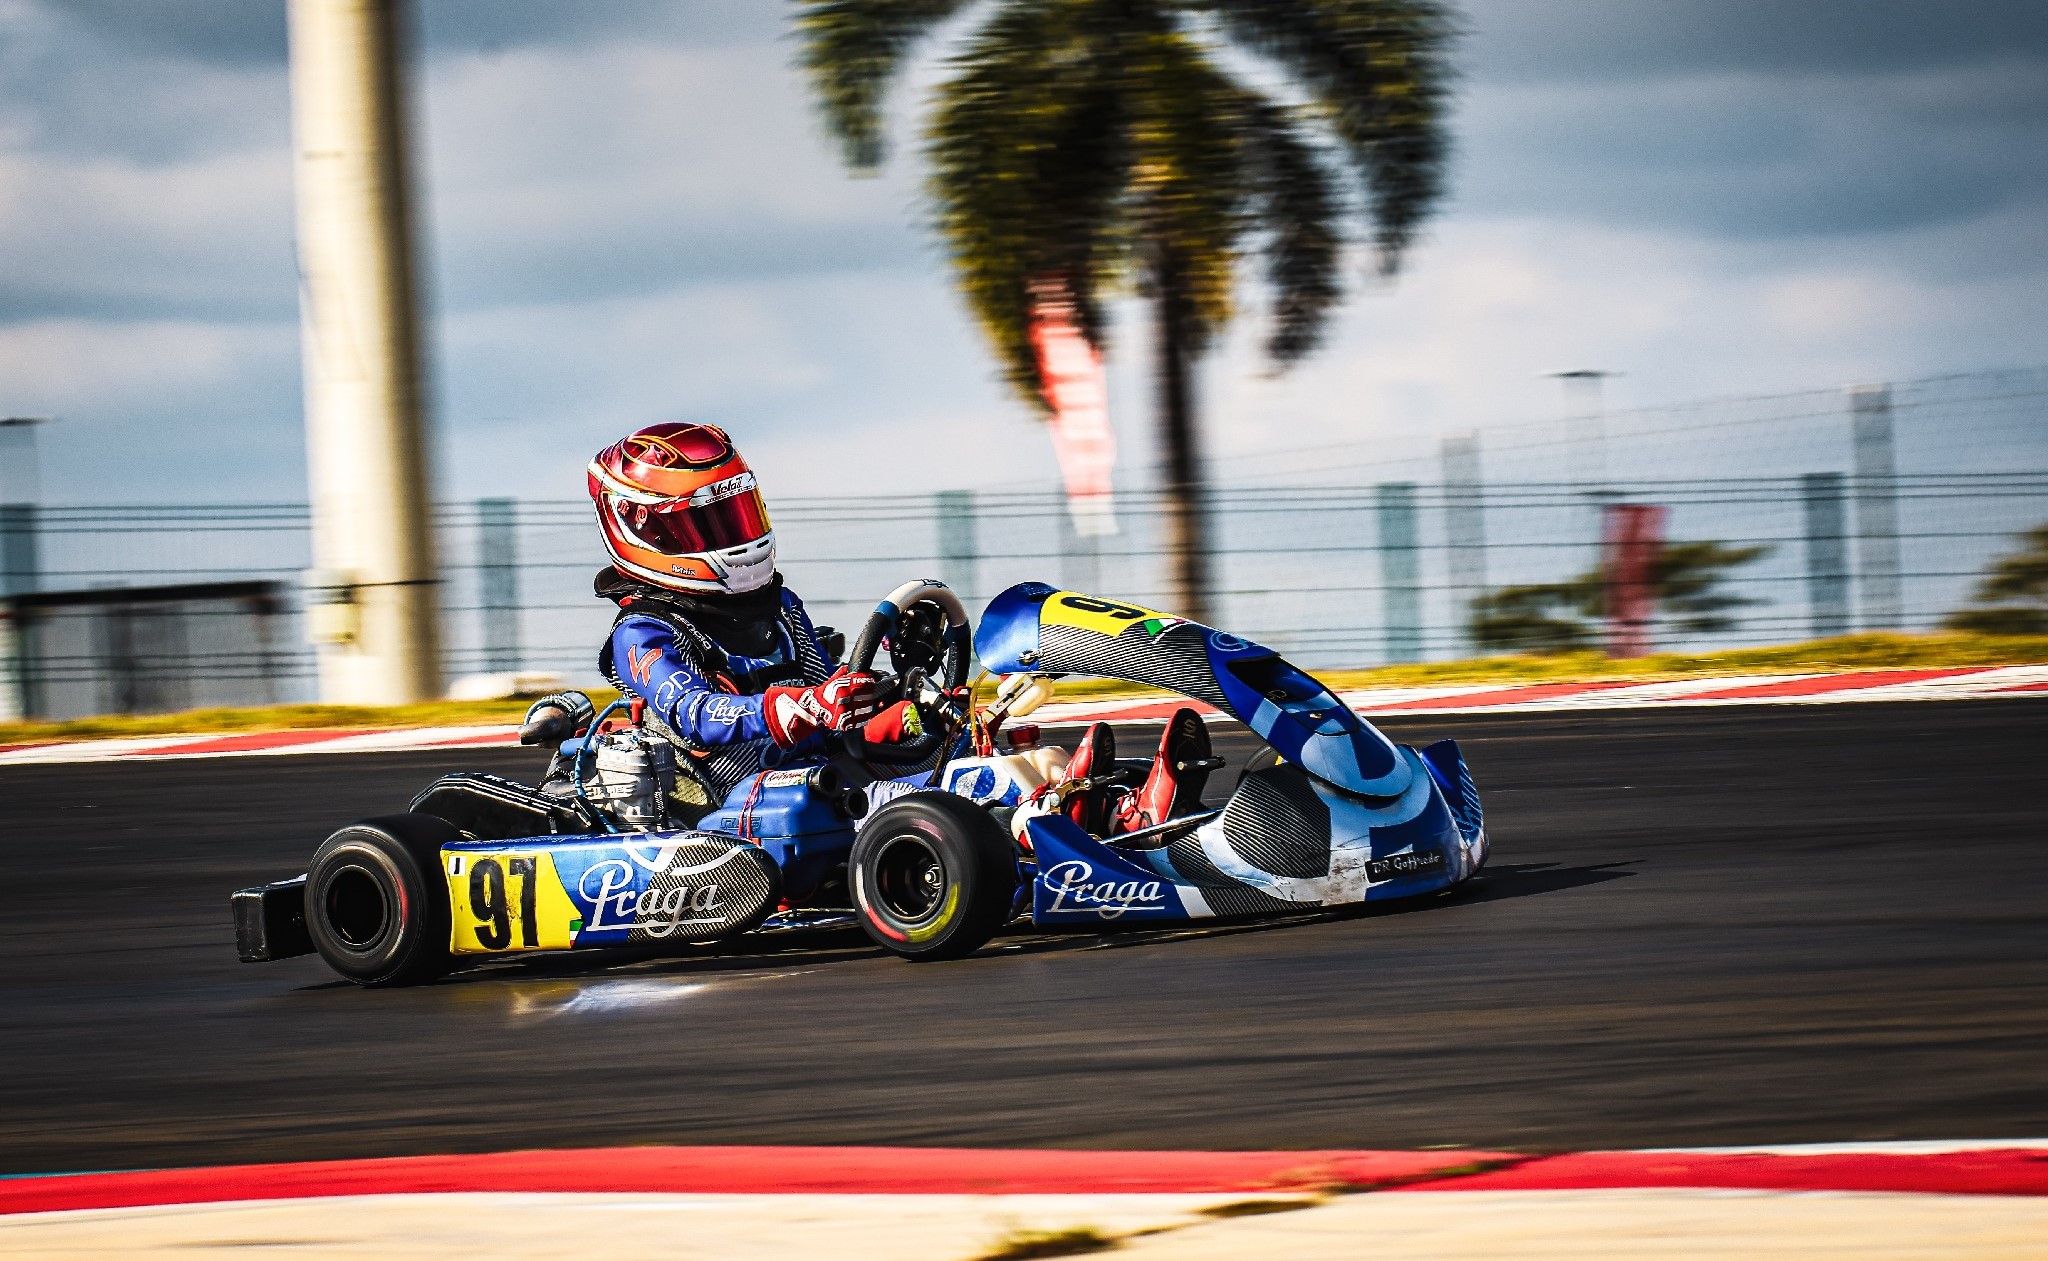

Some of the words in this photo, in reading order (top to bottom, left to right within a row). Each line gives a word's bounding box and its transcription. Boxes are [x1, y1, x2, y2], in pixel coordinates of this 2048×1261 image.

[469, 856, 541, 951] 97
[579, 859, 728, 938] Praga
[1044, 860, 1165, 920] Praga
